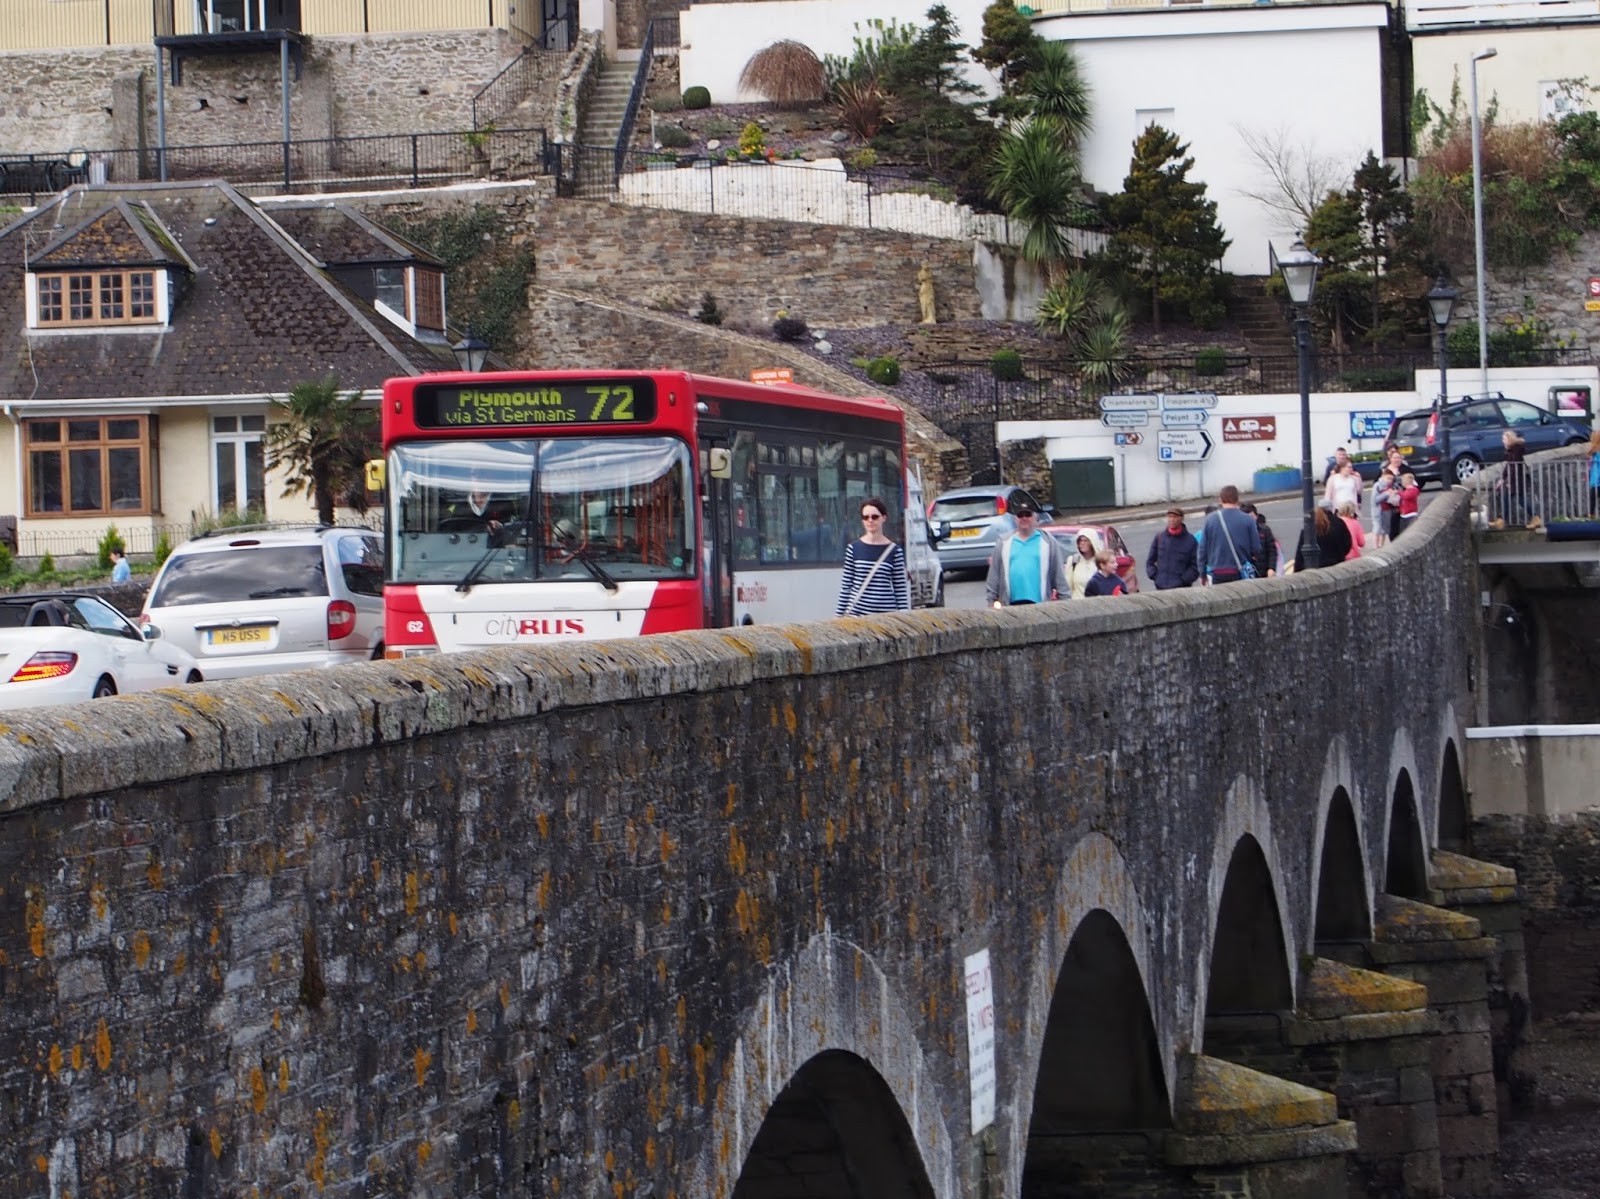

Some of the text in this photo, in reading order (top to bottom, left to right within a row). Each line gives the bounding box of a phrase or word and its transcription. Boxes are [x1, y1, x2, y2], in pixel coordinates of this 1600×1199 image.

[459, 388, 562, 407] Plymouth
[586, 386, 634, 420] 72
[445, 407, 576, 424] via St Germans
[239, 629, 261, 641] USS
[406, 620, 424, 633] 62
